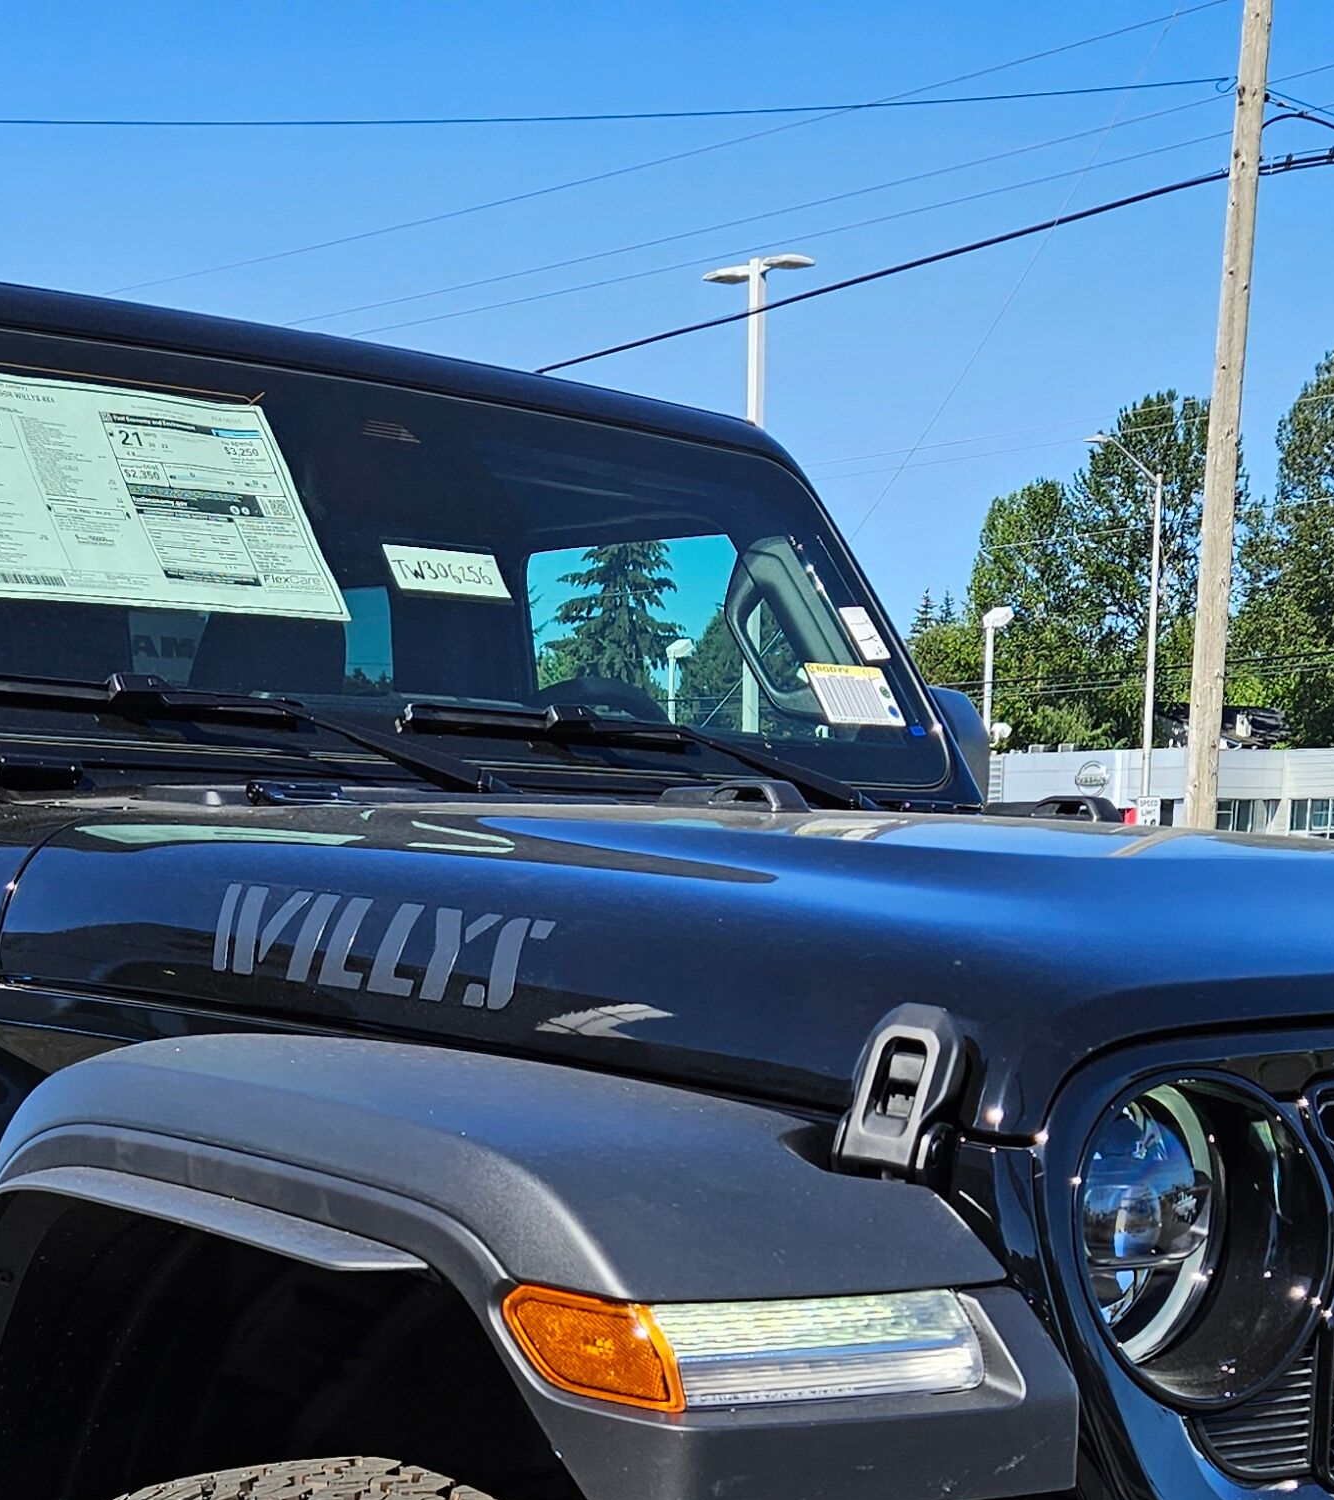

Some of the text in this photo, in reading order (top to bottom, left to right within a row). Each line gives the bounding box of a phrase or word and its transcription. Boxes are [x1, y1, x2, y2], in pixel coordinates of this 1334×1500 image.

[118, 430, 143, 447] 21
[124, 469, 160, 480] $2,350
[263, 574, 320, 585] FlexCare
[213, 883, 557, 1010] WILLYS
